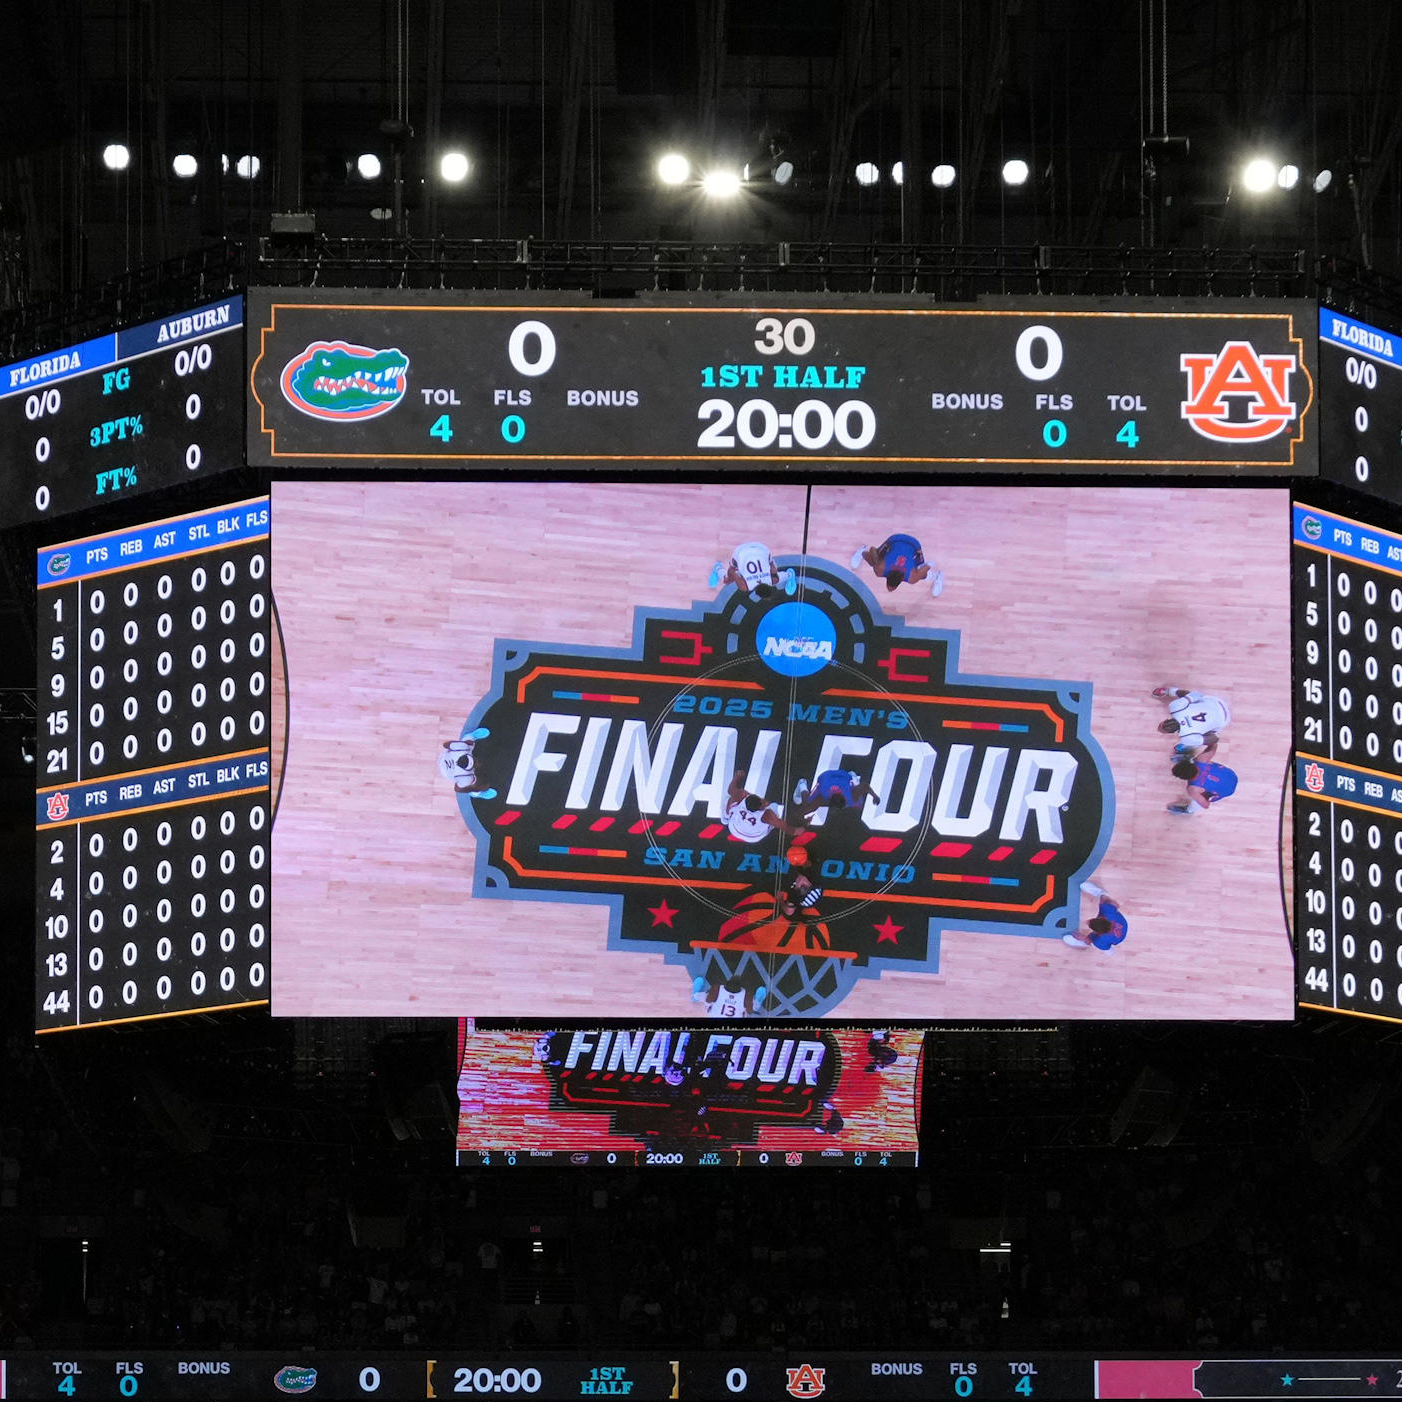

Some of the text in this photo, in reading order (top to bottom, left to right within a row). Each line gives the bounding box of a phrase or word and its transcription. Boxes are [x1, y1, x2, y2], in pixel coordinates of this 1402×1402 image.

[156, 304, 230, 344] AUBURN
[754, 317, 815, 356] 30
[507, 320, 557, 377] 0
[1331, 318, 1394, 359] FLORIDA
[1015, 325, 1064, 383] 0
[9, 352, 81, 387] FLORIDA
[700, 364, 867, 389] 1ST HALF
[1345, 356, 1377, 390] 0/0
[25, 344, 212, 421] 0/0 FG 0/0
[421, 390, 639, 406] TOL FLS BONUS
[931, 394, 1147, 412] BONUS FLS TOL
[35, 394, 201, 462] 0 3PT% 0
[429, 416, 526, 442] 4 0
[697, 399, 876, 450] 20:00
[1042, 420, 1140, 448] 0 4
[35, 444, 201, 511] 0 FT% 0
[86, 510, 268, 564] PTS REB AST STL BLK FLS
[1333, 528, 1352, 546] PTS
[1361, 537, 1380, 555] REB
[53, 599, 63, 622] 1
[51, 636, 65, 660] 5
[763, 636, 832, 660] NCAA
[51, 674, 65, 697] 9
[47, 710, 69, 735] 15
[672, 695, 910, 730] 2025 MEN'S
[47, 748, 68, 773] 21
[85, 761, 268, 807] PTS REB AST STL BLK FLS
[1337, 775, 1355, 792] PTS
[1364, 781, 1383, 798] REB
[50, 840, 64, 864] 2
[643, 846, 916, 884] SAN ANONIO
[50, 877, 64, 901] 4
[45, 914, 69, 940] 10
[46, 952, 68, 978] 13
[43, 990, 70, 1015] 44
[720, 1004, 736, 1017] 13
[607, 1153, 683, 1164] 0 20:00
[759, 1153, 769, 1164] 0
[53, 1362, 231, 1375] TOL FLS BONUS
[359, 1366, 381, 1392] 0
[454, 1367, 542, 1393] 20:00
[589, 1367, 625, 1380] 1ST
[726, 1367, 748, 1392] 0
[871, 1362, 1038, 1375] BONUS FLS TOL
[57, 1376, 138, 1397] 4 0
[580, 1381, 633, 1395] HALF
[954, 1376, 1033, 1397] 0 4
